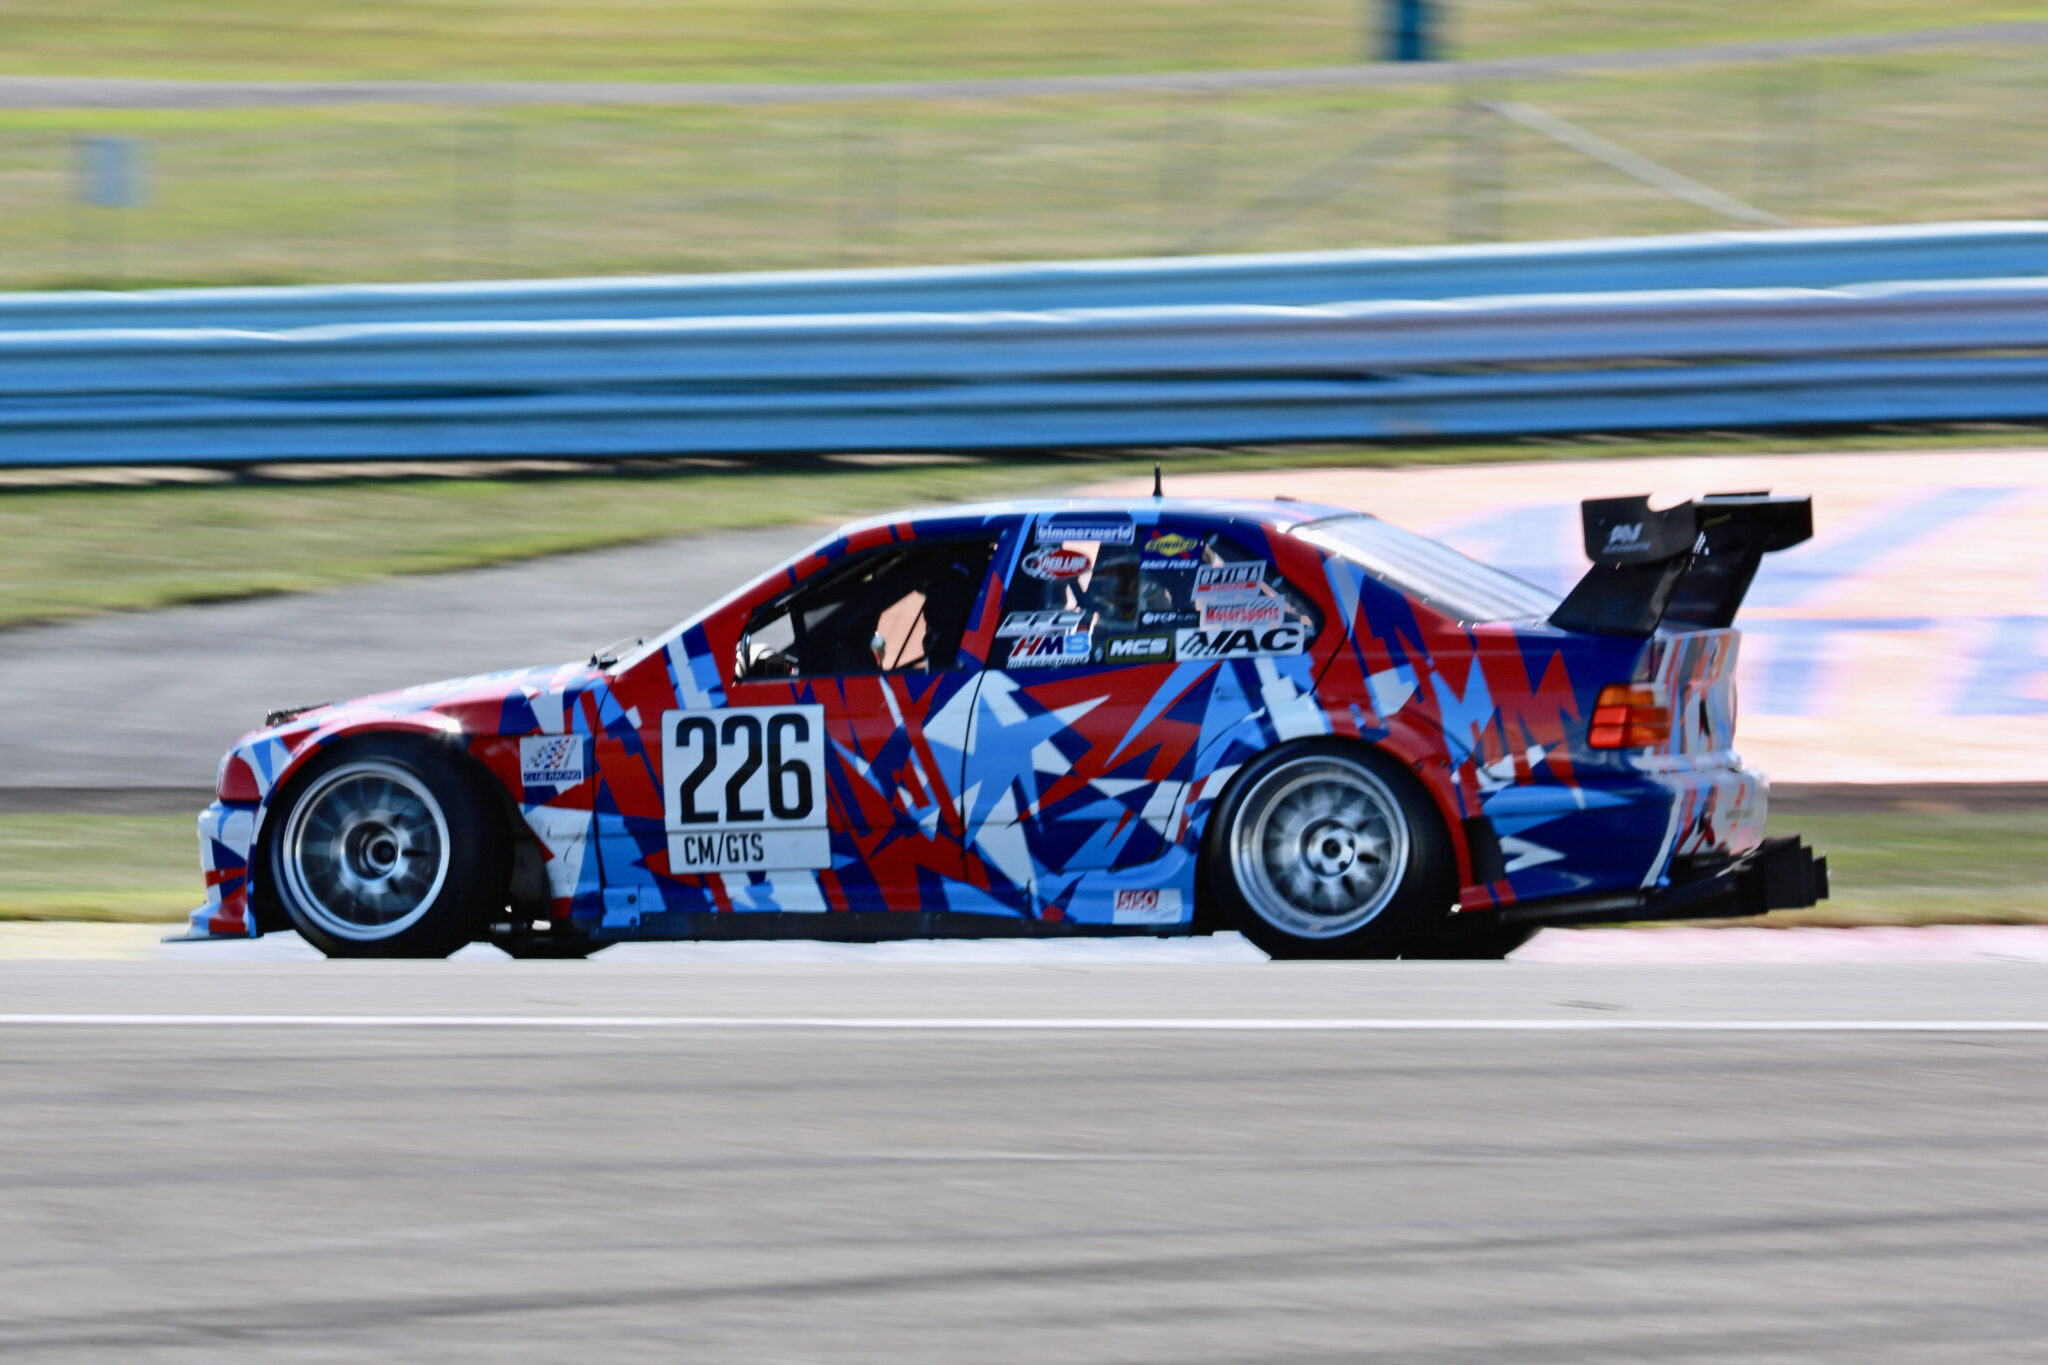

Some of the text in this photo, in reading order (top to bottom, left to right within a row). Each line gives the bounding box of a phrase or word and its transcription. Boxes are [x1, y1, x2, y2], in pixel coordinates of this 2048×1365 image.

[1038, 524, 1132, 540] bimmerworld
[1145, 538, 1198, 552] SUNOCO
[1042, 556, 1088, 571] RED LINE
[1141, 559, 1199, 570] RACE FUELS
[1200, 566, 1261, 584] OPTIMA
[1206, 607, 1279, 623] Motorsports
[1011, 632, 1090, 657] HMS
[1110, 637, 1169, 656] MCS
[548, 770, 581, 781] RACING
[676, 713, 813, 824] 226
[684, 832, 764, 866] CM/GTS
